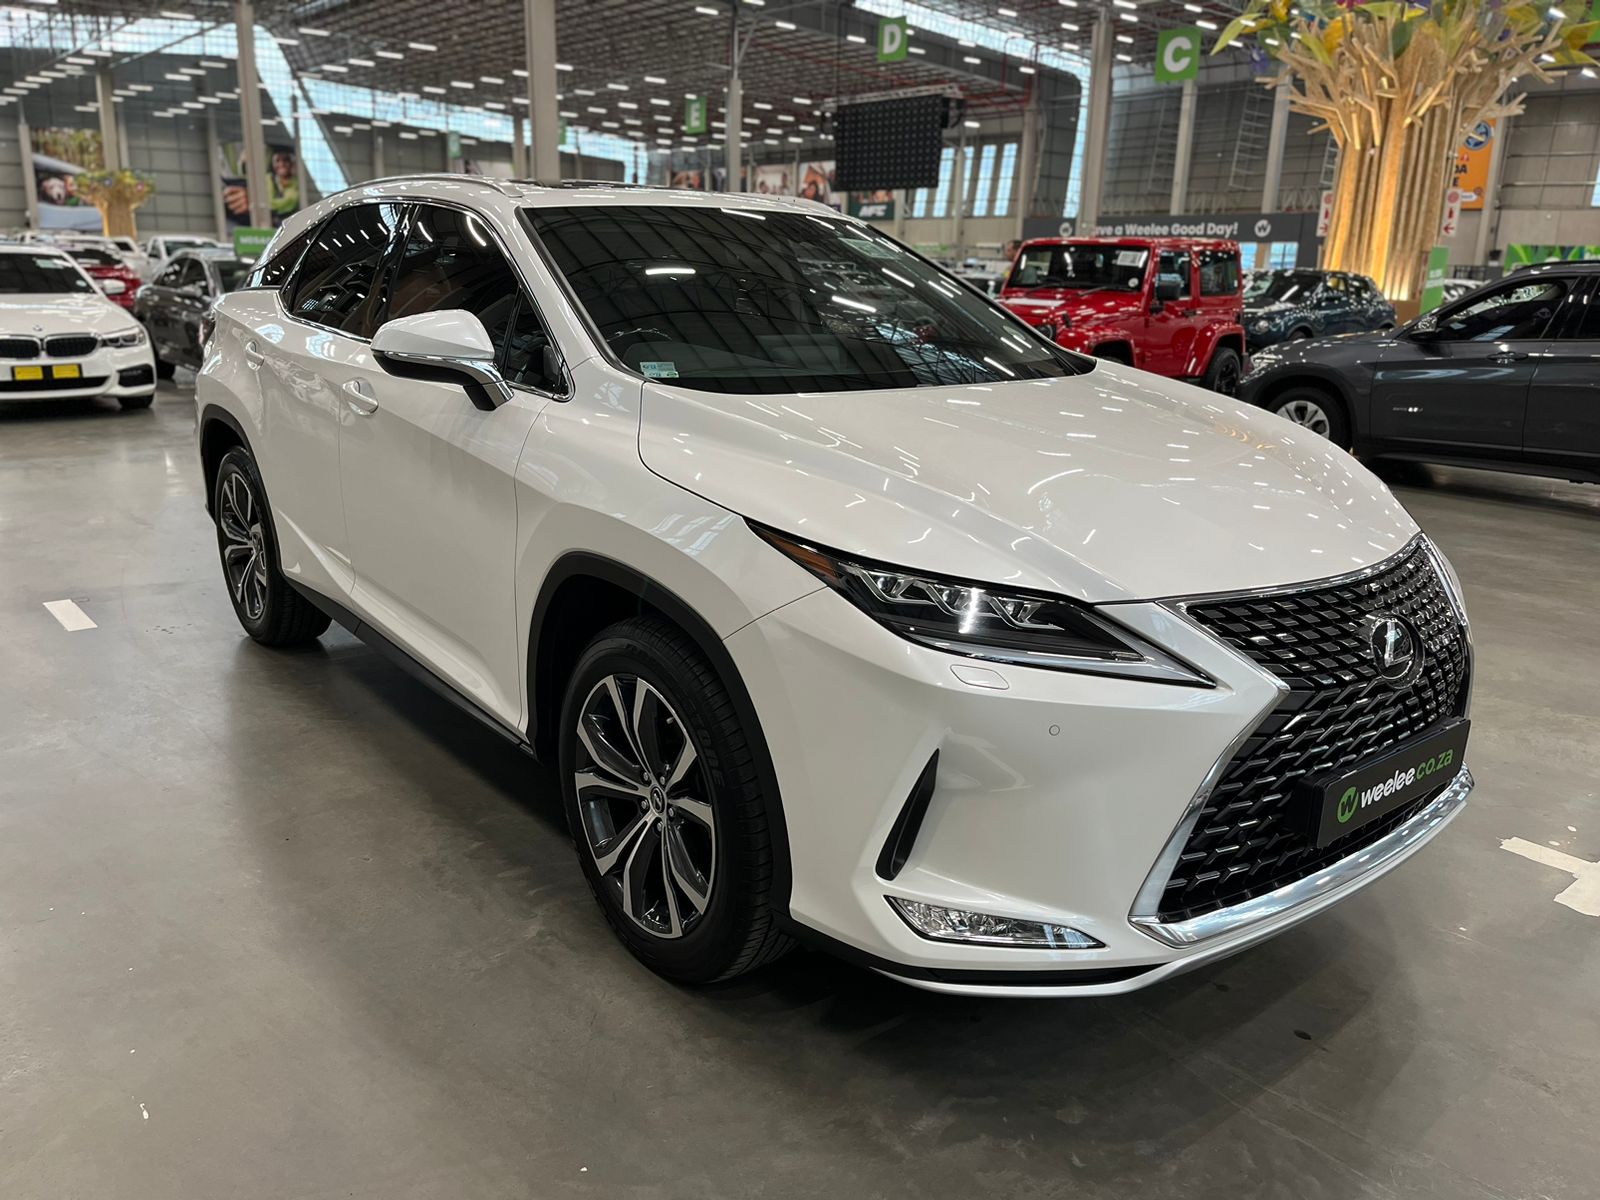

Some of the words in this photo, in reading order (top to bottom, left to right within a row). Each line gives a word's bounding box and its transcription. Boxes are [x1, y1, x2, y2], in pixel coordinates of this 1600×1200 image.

[883, 24, 901, 54] D
[1163, 36, 1192, 73] C
[690, 102, 700, 128] E
[1114, 225, 1123, 236] a
[1124, 223, 1169, 236] Weelee
[1171, 221, 1205, 235] Good
[1206, 221, 1239, 239] Day!
[1361, 749, 1453, 808] weelee.co.za
